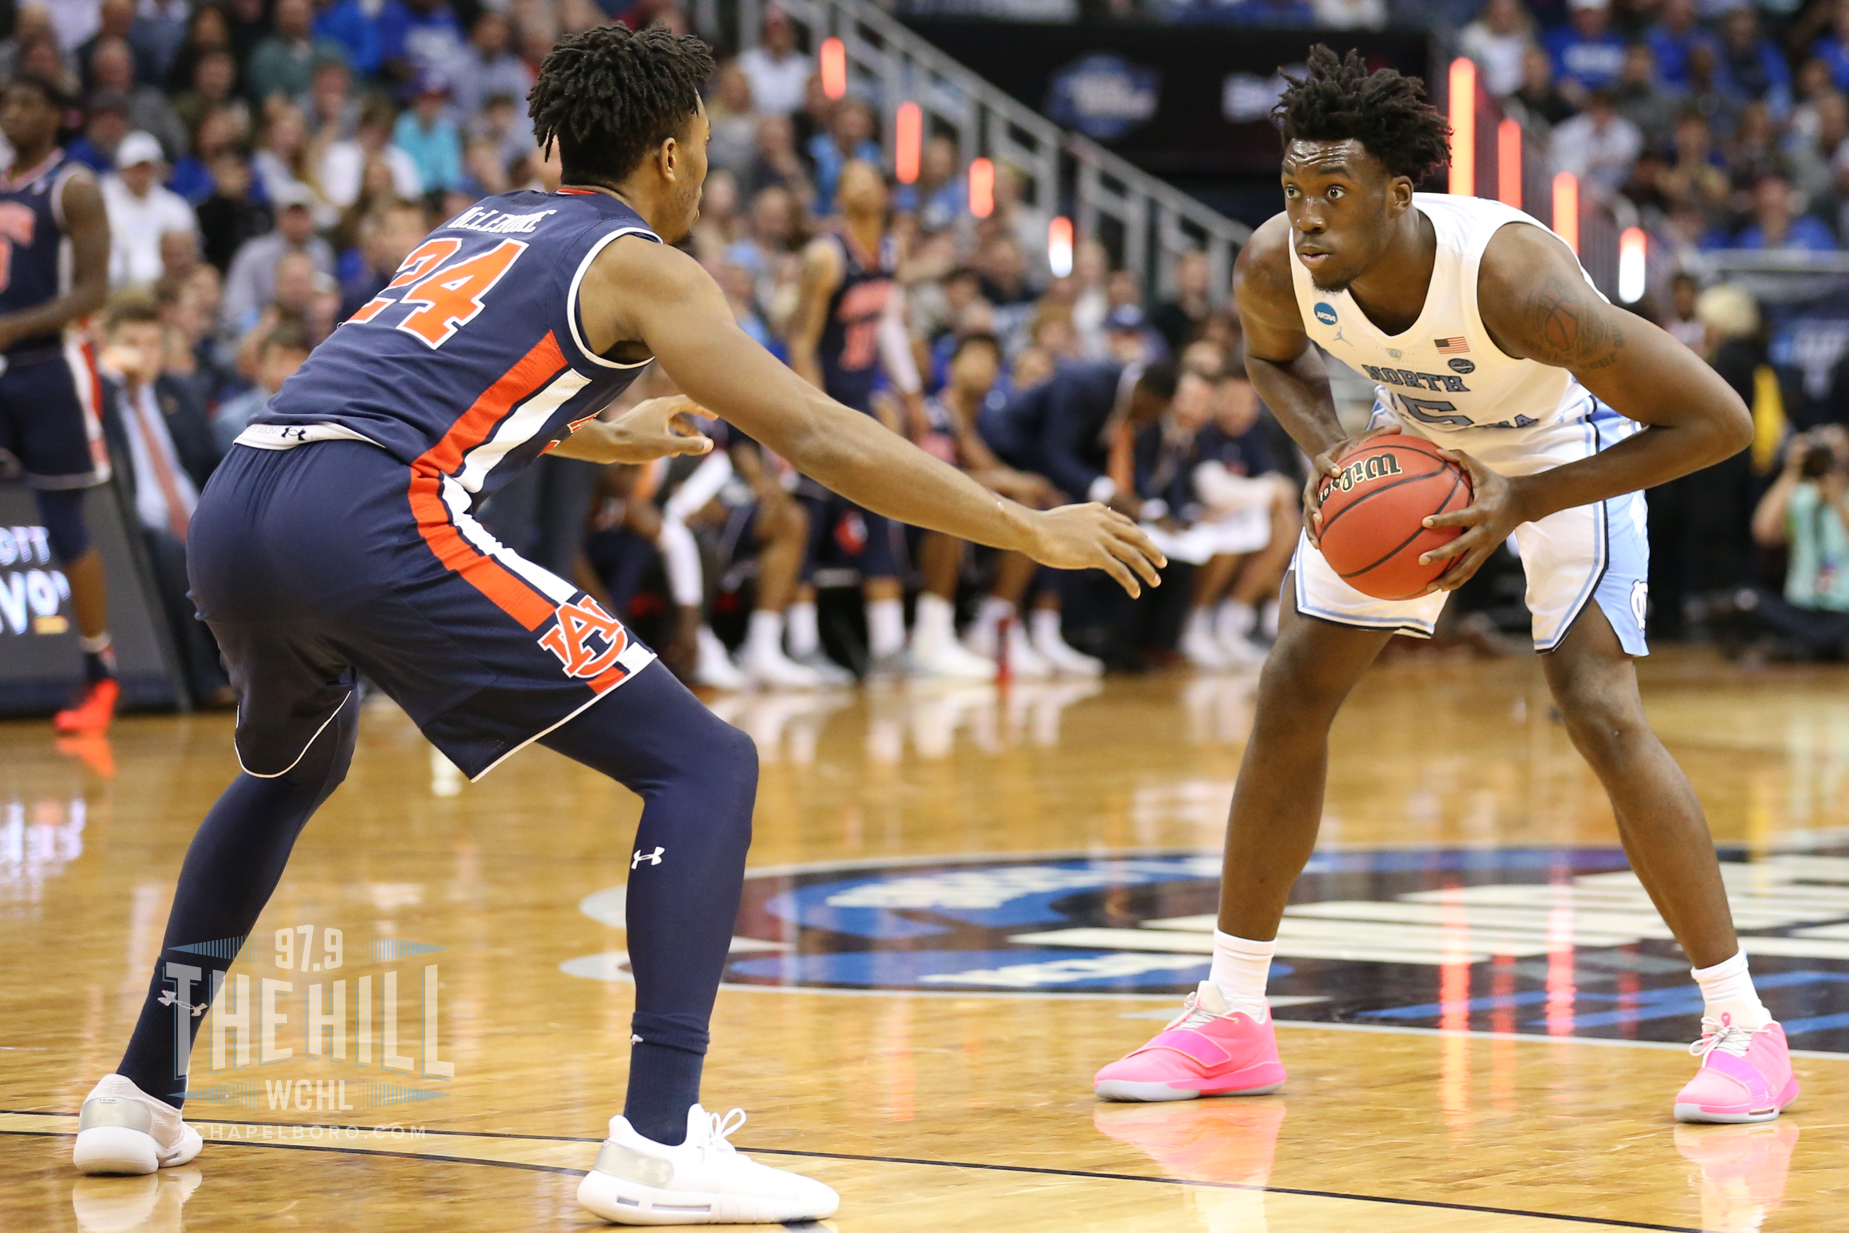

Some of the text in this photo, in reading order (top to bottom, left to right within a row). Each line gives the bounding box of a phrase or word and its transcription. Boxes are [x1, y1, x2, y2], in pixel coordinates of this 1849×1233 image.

[338, 238, 529, 350] 24
[1361, 364, 1471, 392] NORTH
[1397, 393, 1475, 427] 5
